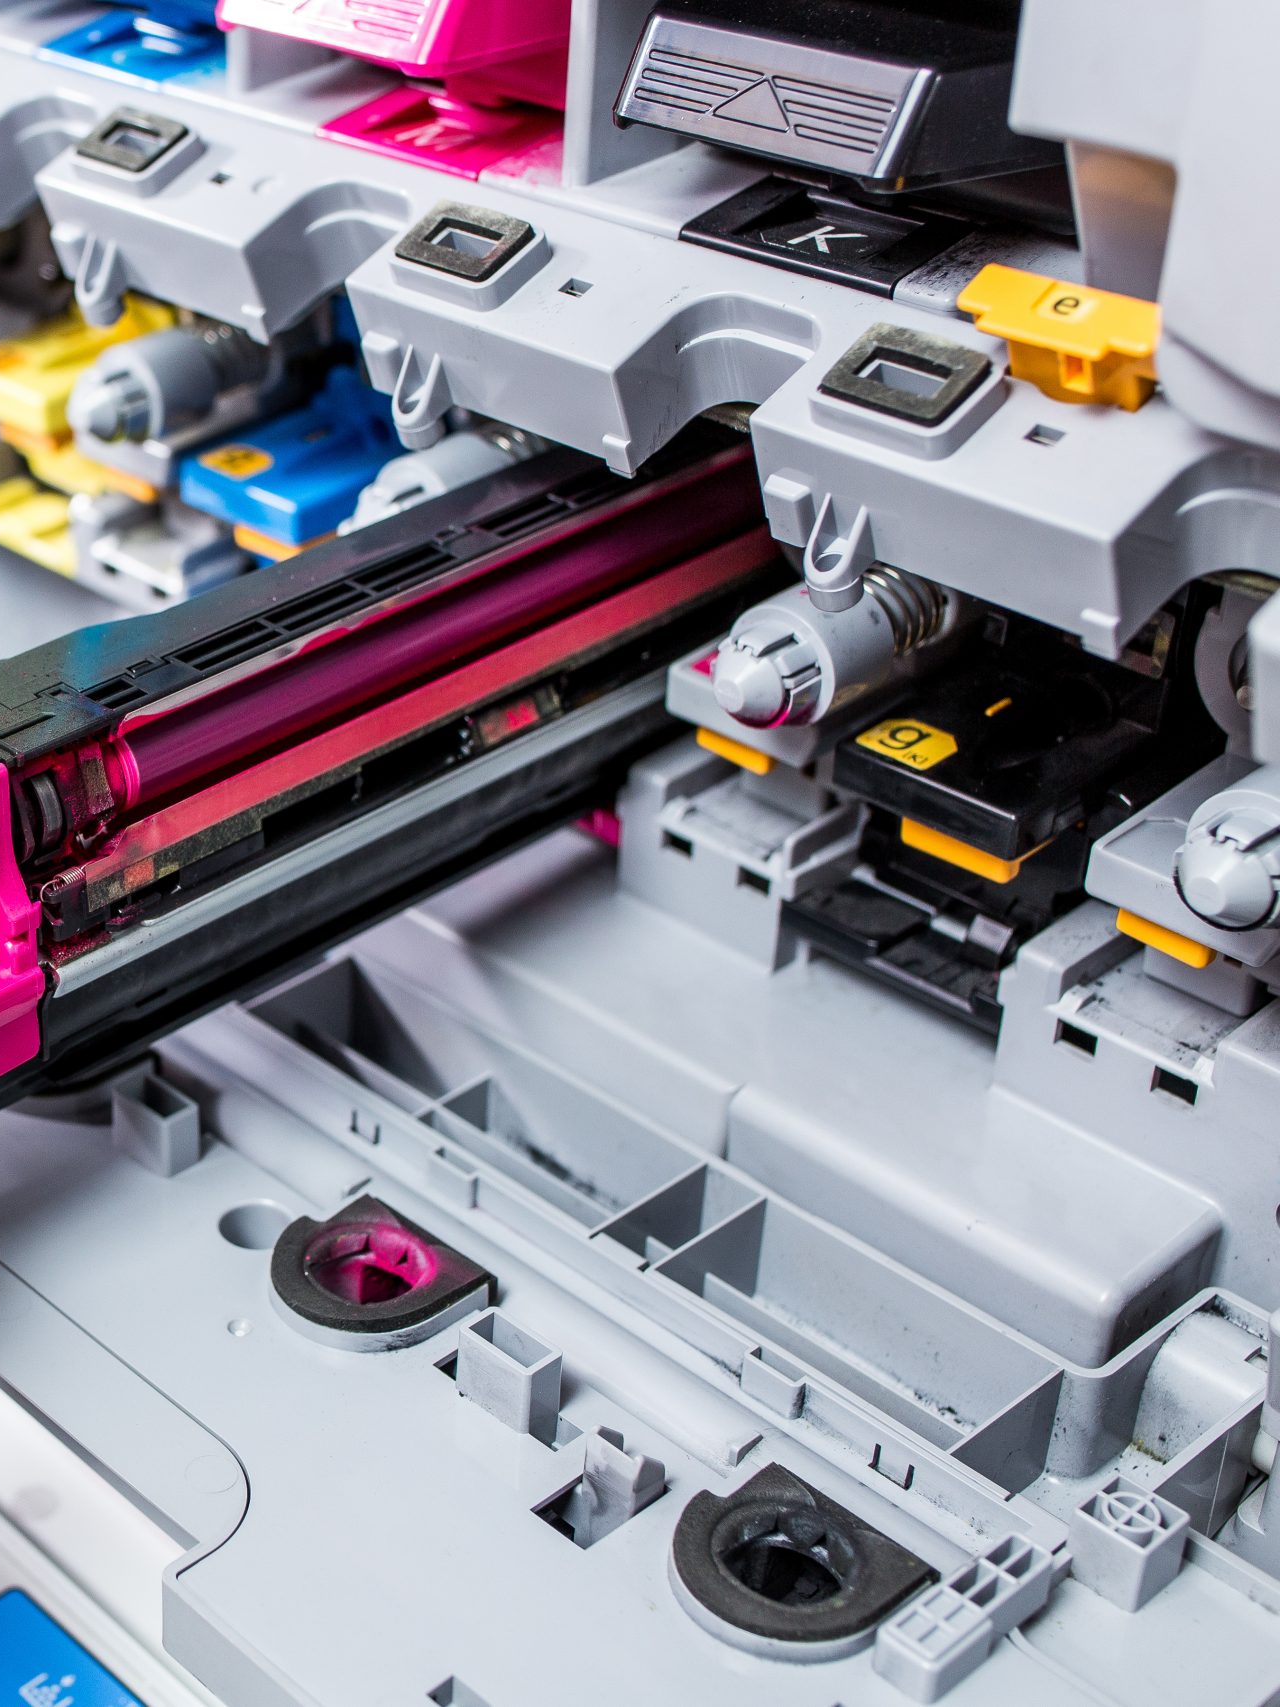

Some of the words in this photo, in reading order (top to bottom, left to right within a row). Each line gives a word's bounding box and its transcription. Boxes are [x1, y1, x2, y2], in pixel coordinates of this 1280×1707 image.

[786, 225, 869, 254] K
[1053, 296, 1080, 316] e
[878, 726, 932, 750] g
